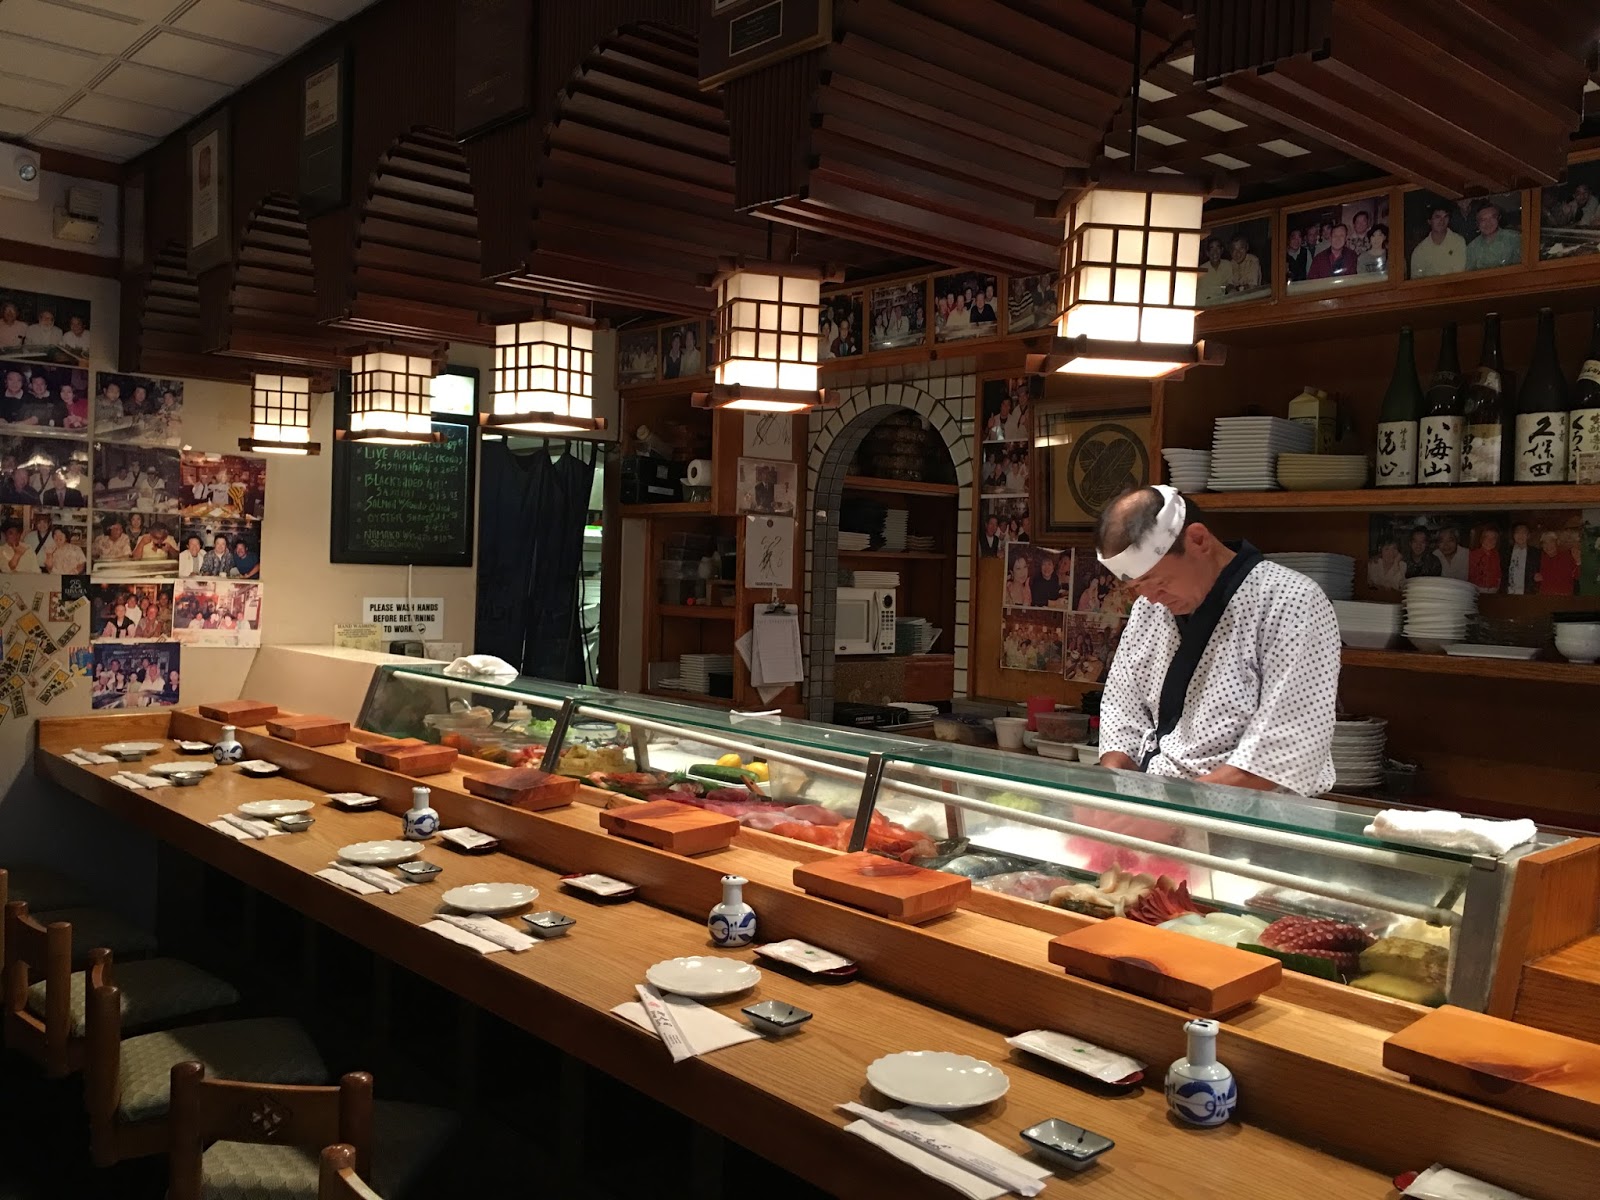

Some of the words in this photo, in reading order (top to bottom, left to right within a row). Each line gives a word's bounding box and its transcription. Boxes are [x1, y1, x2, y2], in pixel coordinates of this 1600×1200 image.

[365, 447, 388, 460] LIVE
[1377, 430, 1398, 477] 洗心
[1424, 422, 1453, 478] 八海山
[1461, 433, 1475, 472] 男山
[1523, 415, 1555, 477] 久保田
[368, 513, 403, 524] OYSTER
[373, 614, 397, 622] BEFORE
[399, 614, 435, 622] RETRNING
[384, 625, 392, 633] TO
